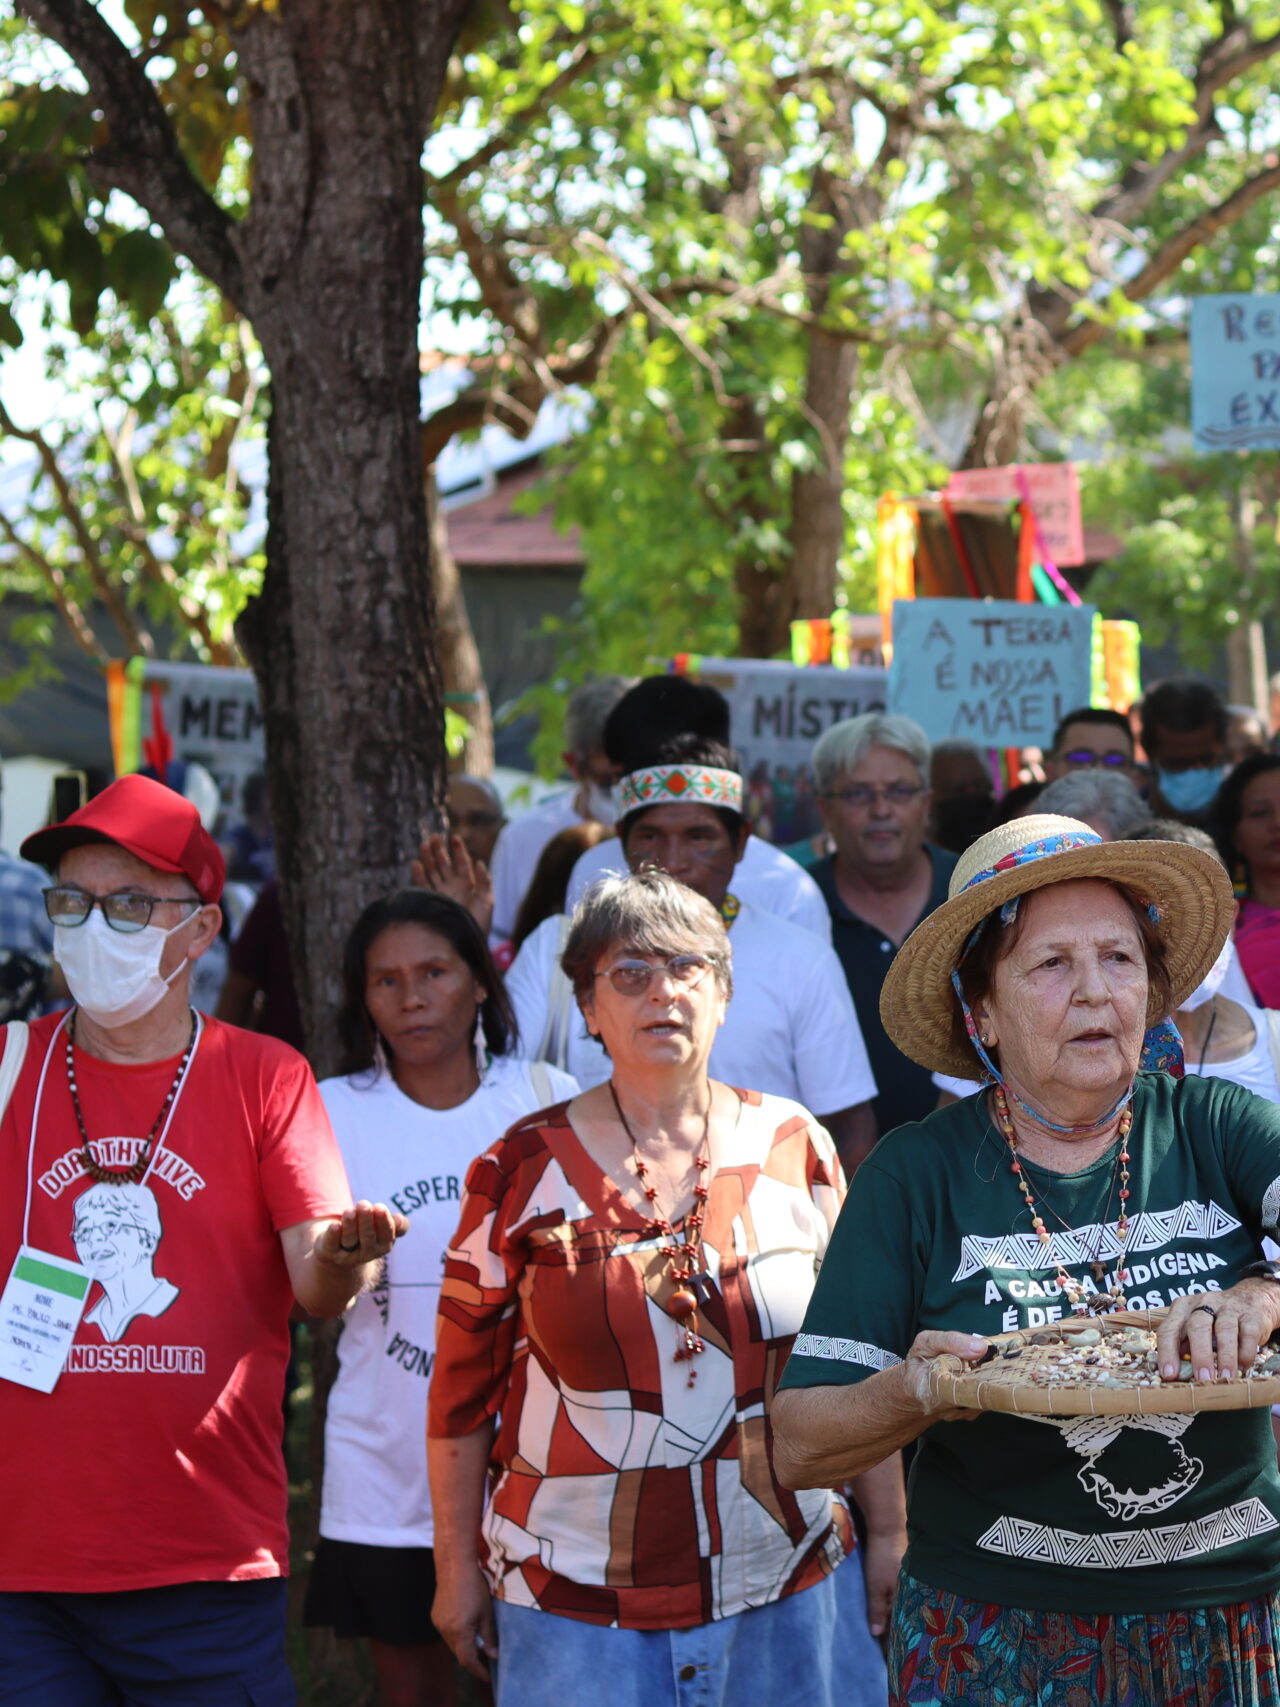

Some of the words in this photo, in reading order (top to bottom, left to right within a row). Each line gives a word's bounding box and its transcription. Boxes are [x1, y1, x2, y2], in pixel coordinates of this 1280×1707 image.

[921, 617, 956, 651] A
[970, 616, 1074, 648] TERRA
[933, 653, 956, 692] É
[151, 1146, 207, 1201] VIVE
[984, 1280, 1003, 1305] A
[1002, 1303, 1019, 1332] É
[69, 1344, 145, 1373] NOSSA
[147, 1345, 206, 1374] LUTA
